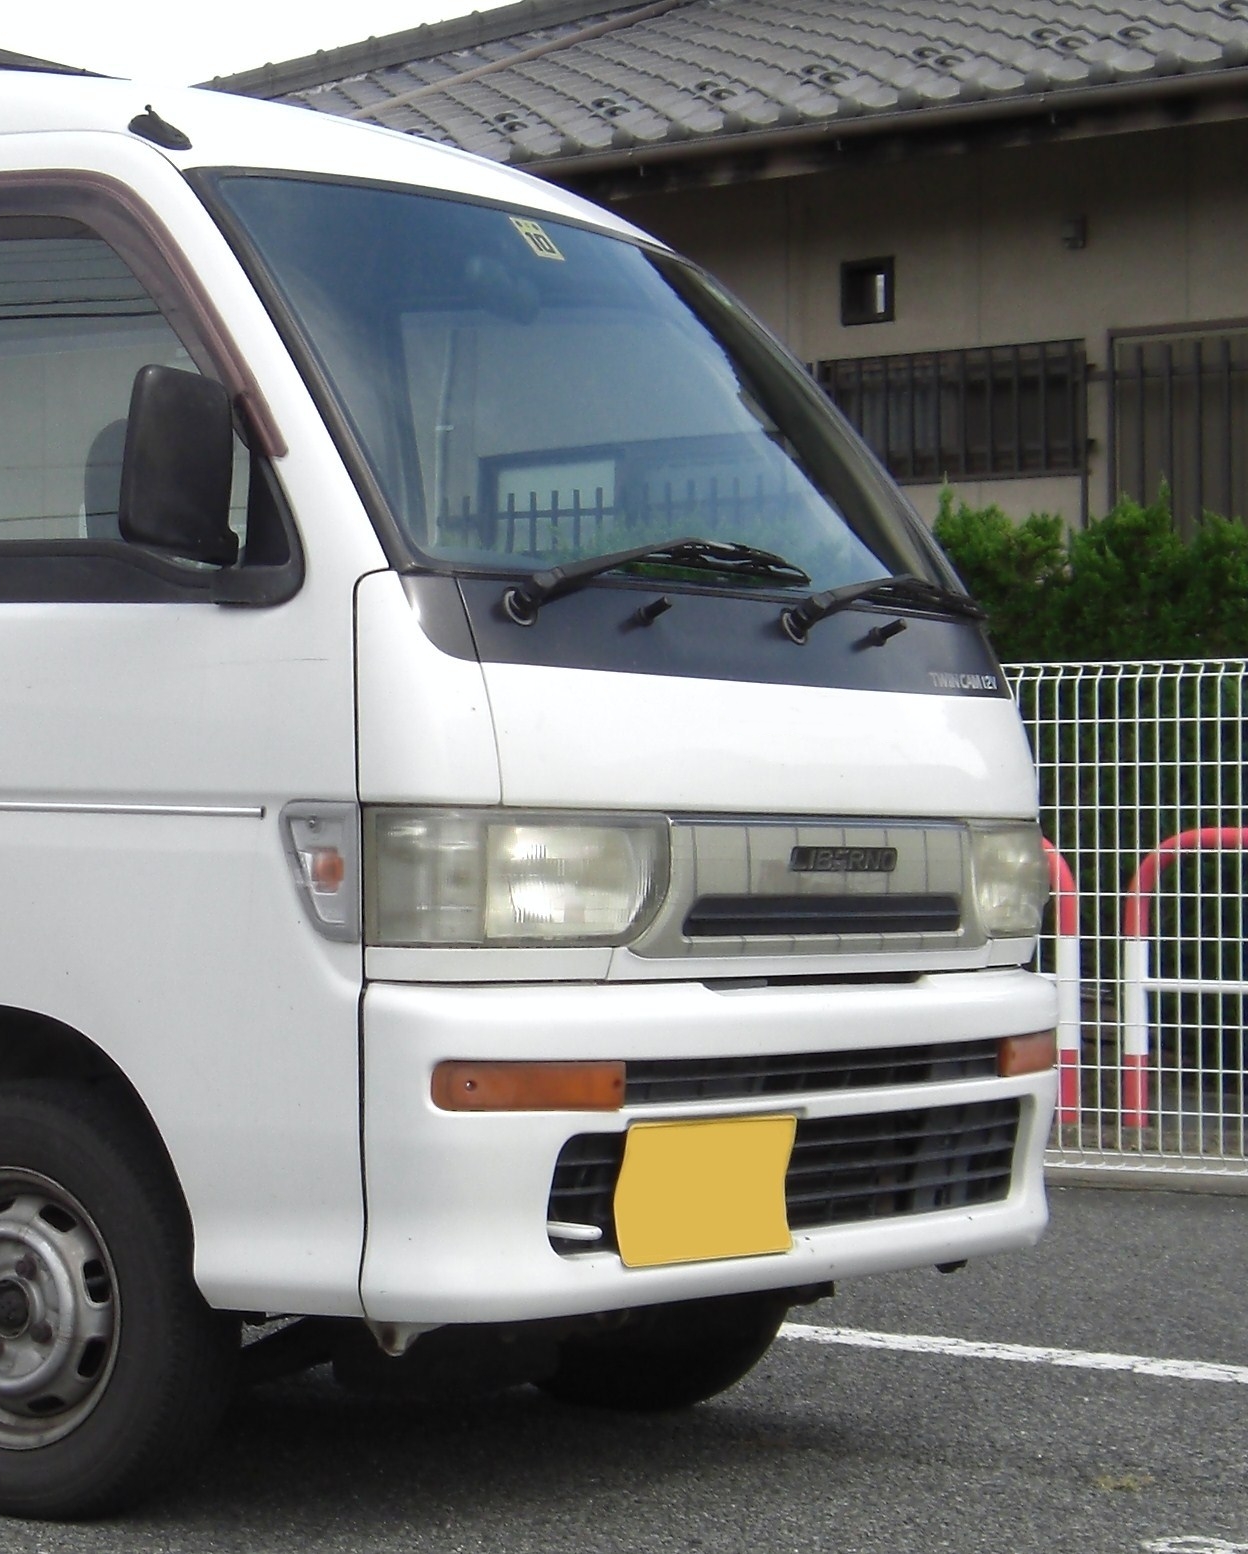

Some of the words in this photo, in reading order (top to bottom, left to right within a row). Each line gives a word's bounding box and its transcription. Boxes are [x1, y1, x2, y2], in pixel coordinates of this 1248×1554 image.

[524, 231, 556, 254] 10
[928, 672, 960, 689] TWIN
[960, 674, 983, 690] CAM
[791, 847, 898, 872] LIBERNO
